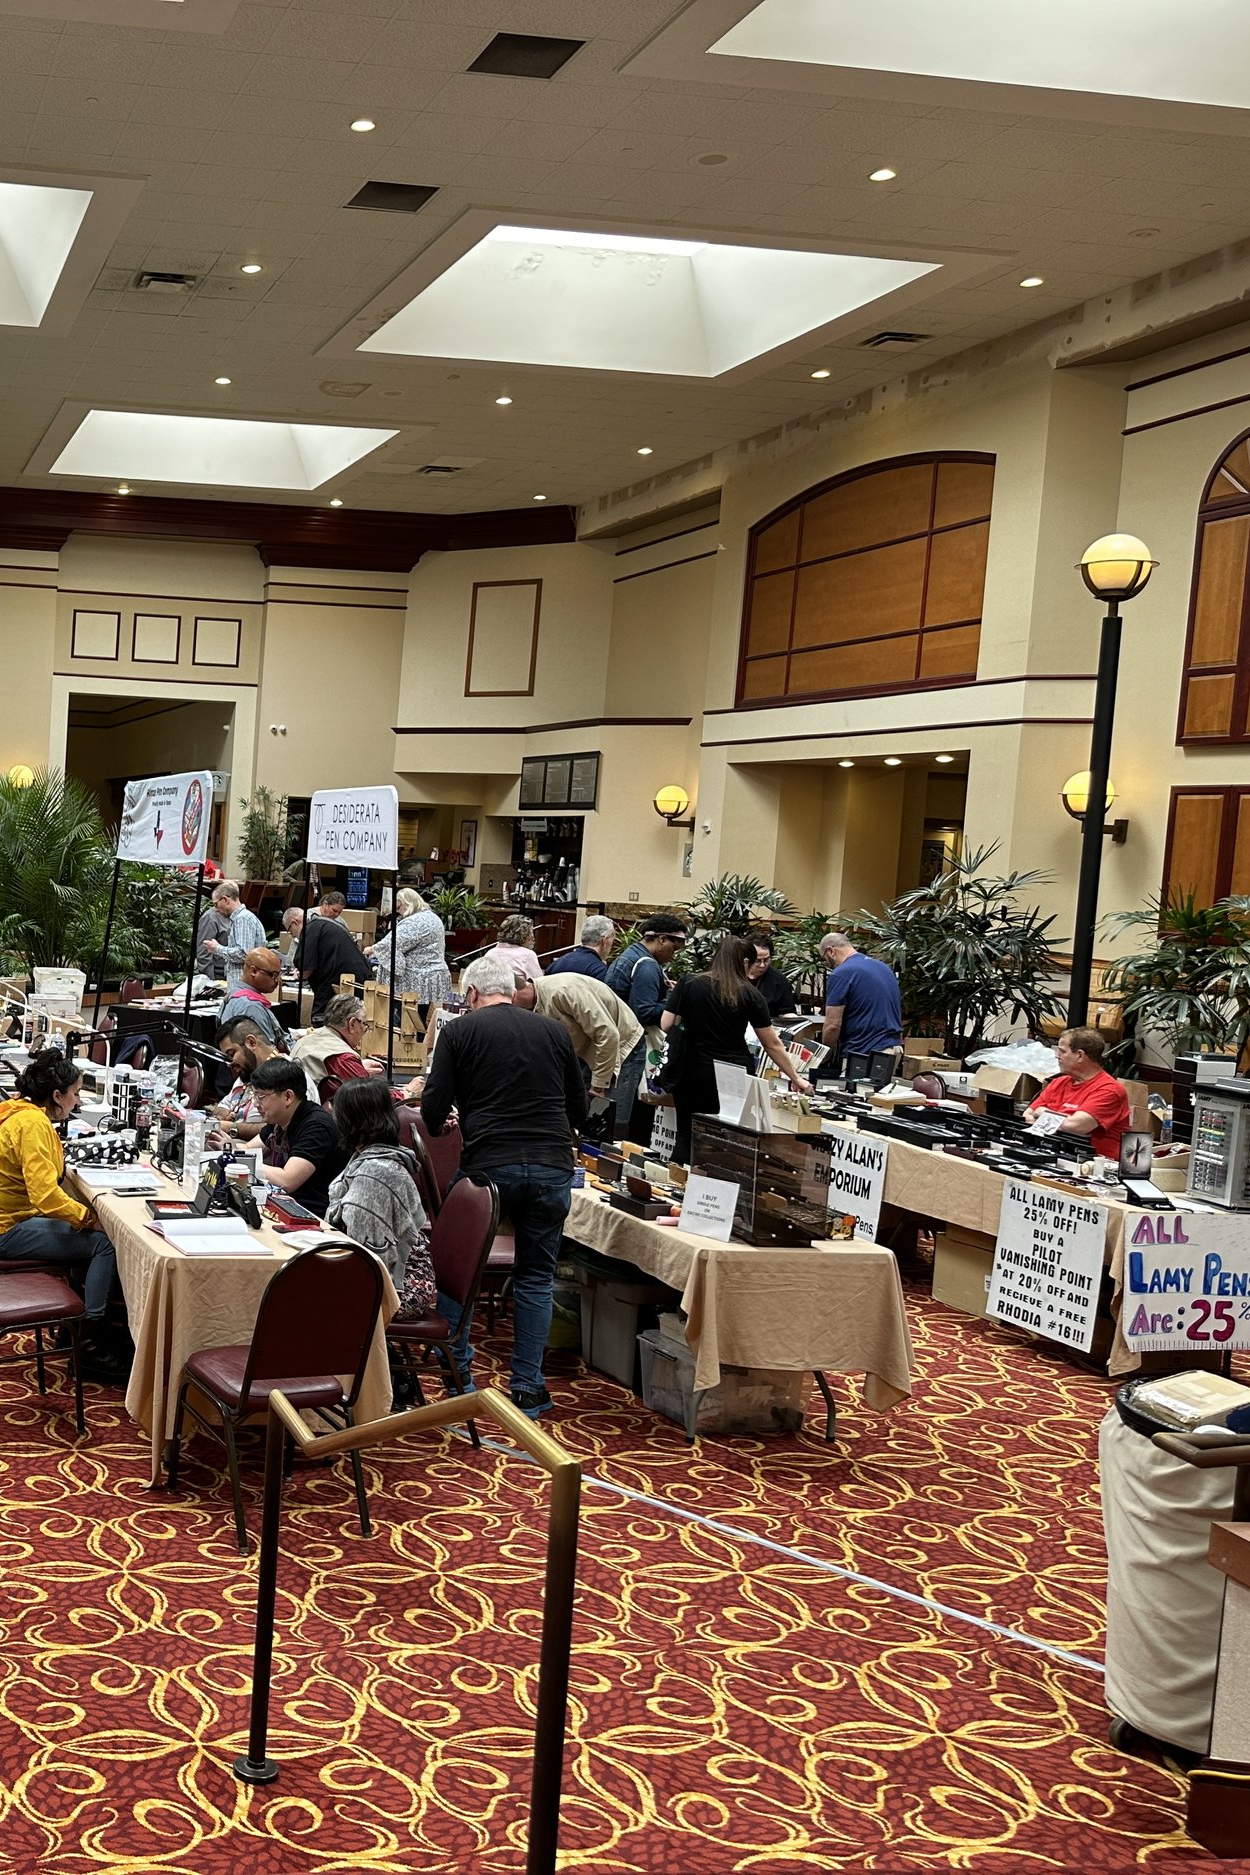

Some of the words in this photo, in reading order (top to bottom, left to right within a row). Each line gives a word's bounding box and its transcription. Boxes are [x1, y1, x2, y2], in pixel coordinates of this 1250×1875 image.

[333, 803, 381, 823] DESIDERATA
[325, 831, 339, 849] PEN
[342, 831, 388, 852] COMPANY
[655, 1139, 664, 1148] OFF
[665, 1143, 673, 1151] AN
[661, 1127, 675, 1140] POIN
[845, 1142, 883, 1172] ALAN'S
[813, 1162, 872, 1200] EMPORIUM
[1010, 1186, 1028, 1204] ALL
[1032, 1193, 1065, 1214] LAMY
[1069, 1204, 1100, 1225] PENS
[1024, 1207, 1048, 1225] 25%
[1053, 1215, 1078, 1234] OFF!
[1131, 1215, 1189, 1244] ALL
[1033, 1229, 1054, 1243] BUY
[1057, 1237, 1064, 1247] A
[1000, 1247, 1055, 1278] VANISHING
[1059, 1268, 1093, 1291] POINT
[1032, 1244, 1063, 1265] PILOT
[1002, 1268, 1015, 1281] AT
[1018, 1273, 1042, 1293] 20%
[1047, 1284, 1066, 1299] OFF
[1067, 1292, 1089, 1308] AND
[1129, 1251, 1194, 1293] LAMY
[1202, 1252, 1250, 1296] PEN
[999, 1286, 1043, 1308] RECIEVE
[1047, 1304, 1054, 1312] A
[1059, 1308, 1087, 1325] FREE
[996, 1299, 1042, 1328] RHODIA
[1047, 1320, 1085, 1344] #16!!!
